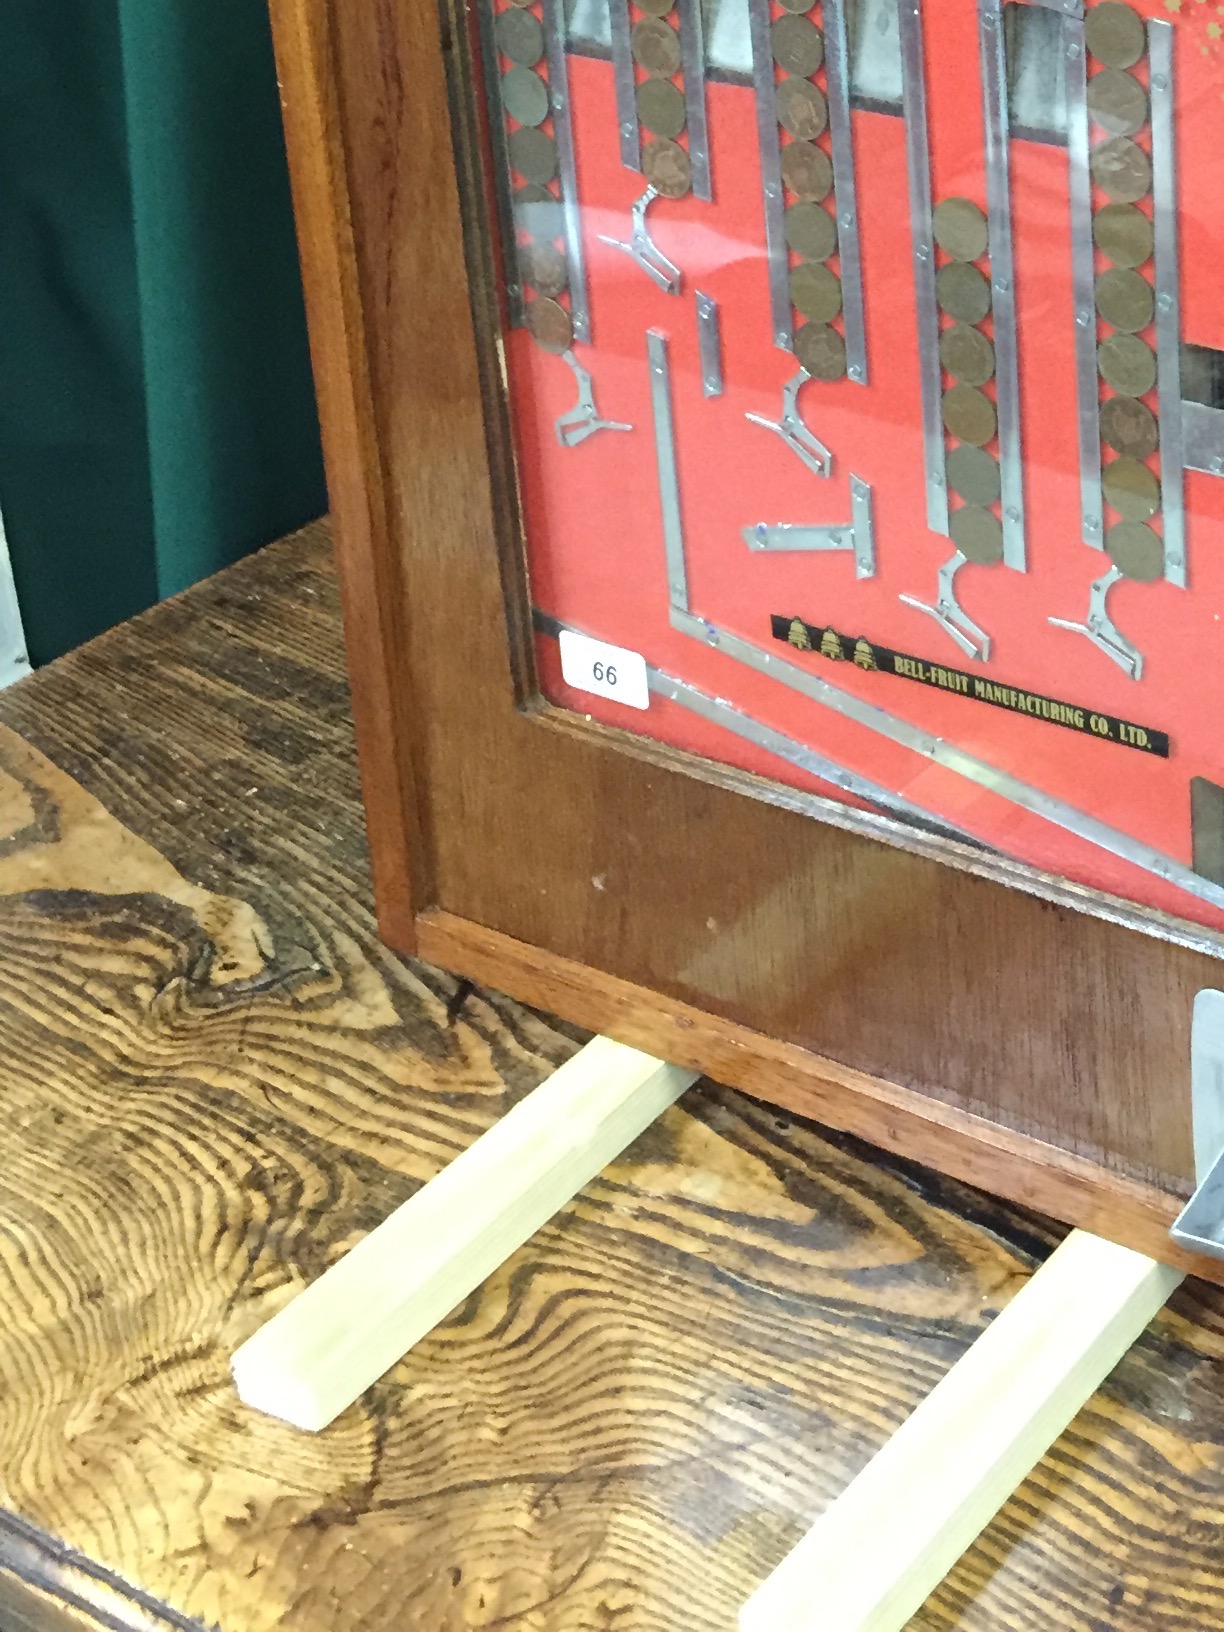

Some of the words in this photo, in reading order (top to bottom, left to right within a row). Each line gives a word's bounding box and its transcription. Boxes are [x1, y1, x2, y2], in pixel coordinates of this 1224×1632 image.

[593, 662, 617, 685] 66
[893, 655, 969, 693] BELL-FRUIT
[974, 678, 1085, 729] MANUFACTURING
[1089, 714, 1114, 737] CO.
[1119, 723, 1152, 749] LTD.
